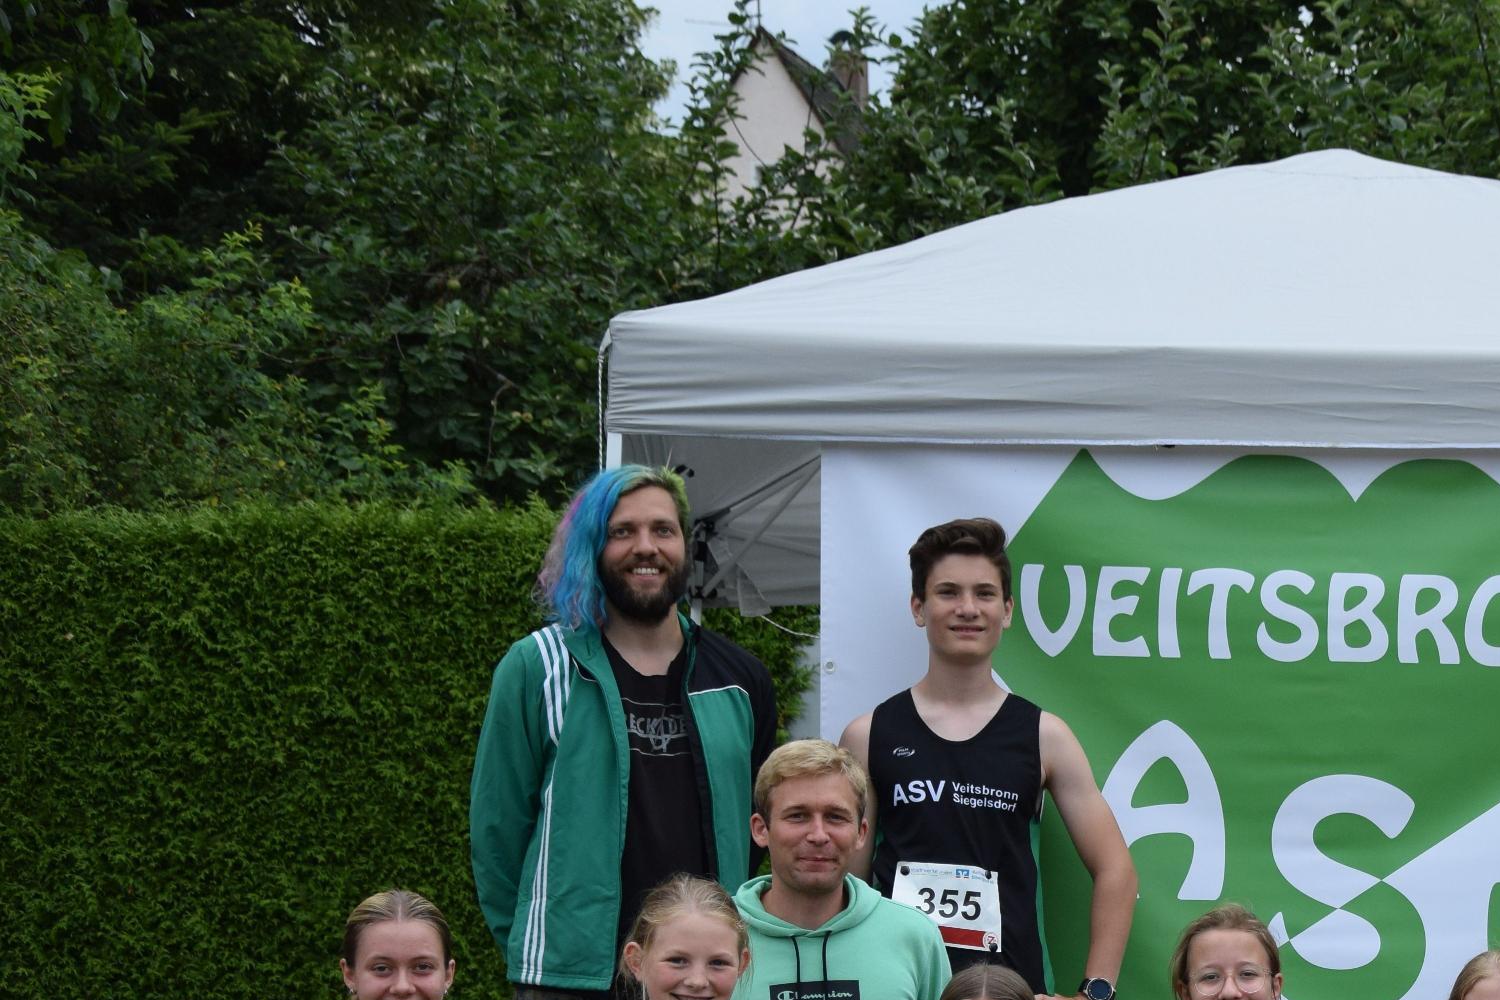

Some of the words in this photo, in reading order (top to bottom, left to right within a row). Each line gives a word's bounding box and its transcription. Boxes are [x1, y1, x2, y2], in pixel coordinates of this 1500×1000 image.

[893, 780, 946, 807] ASV
[952, 781, 1019, 801] Veitsbronn
[953, 793, 1017, 812] Siegelsdorf
[916, 887, 982, 921] 355
